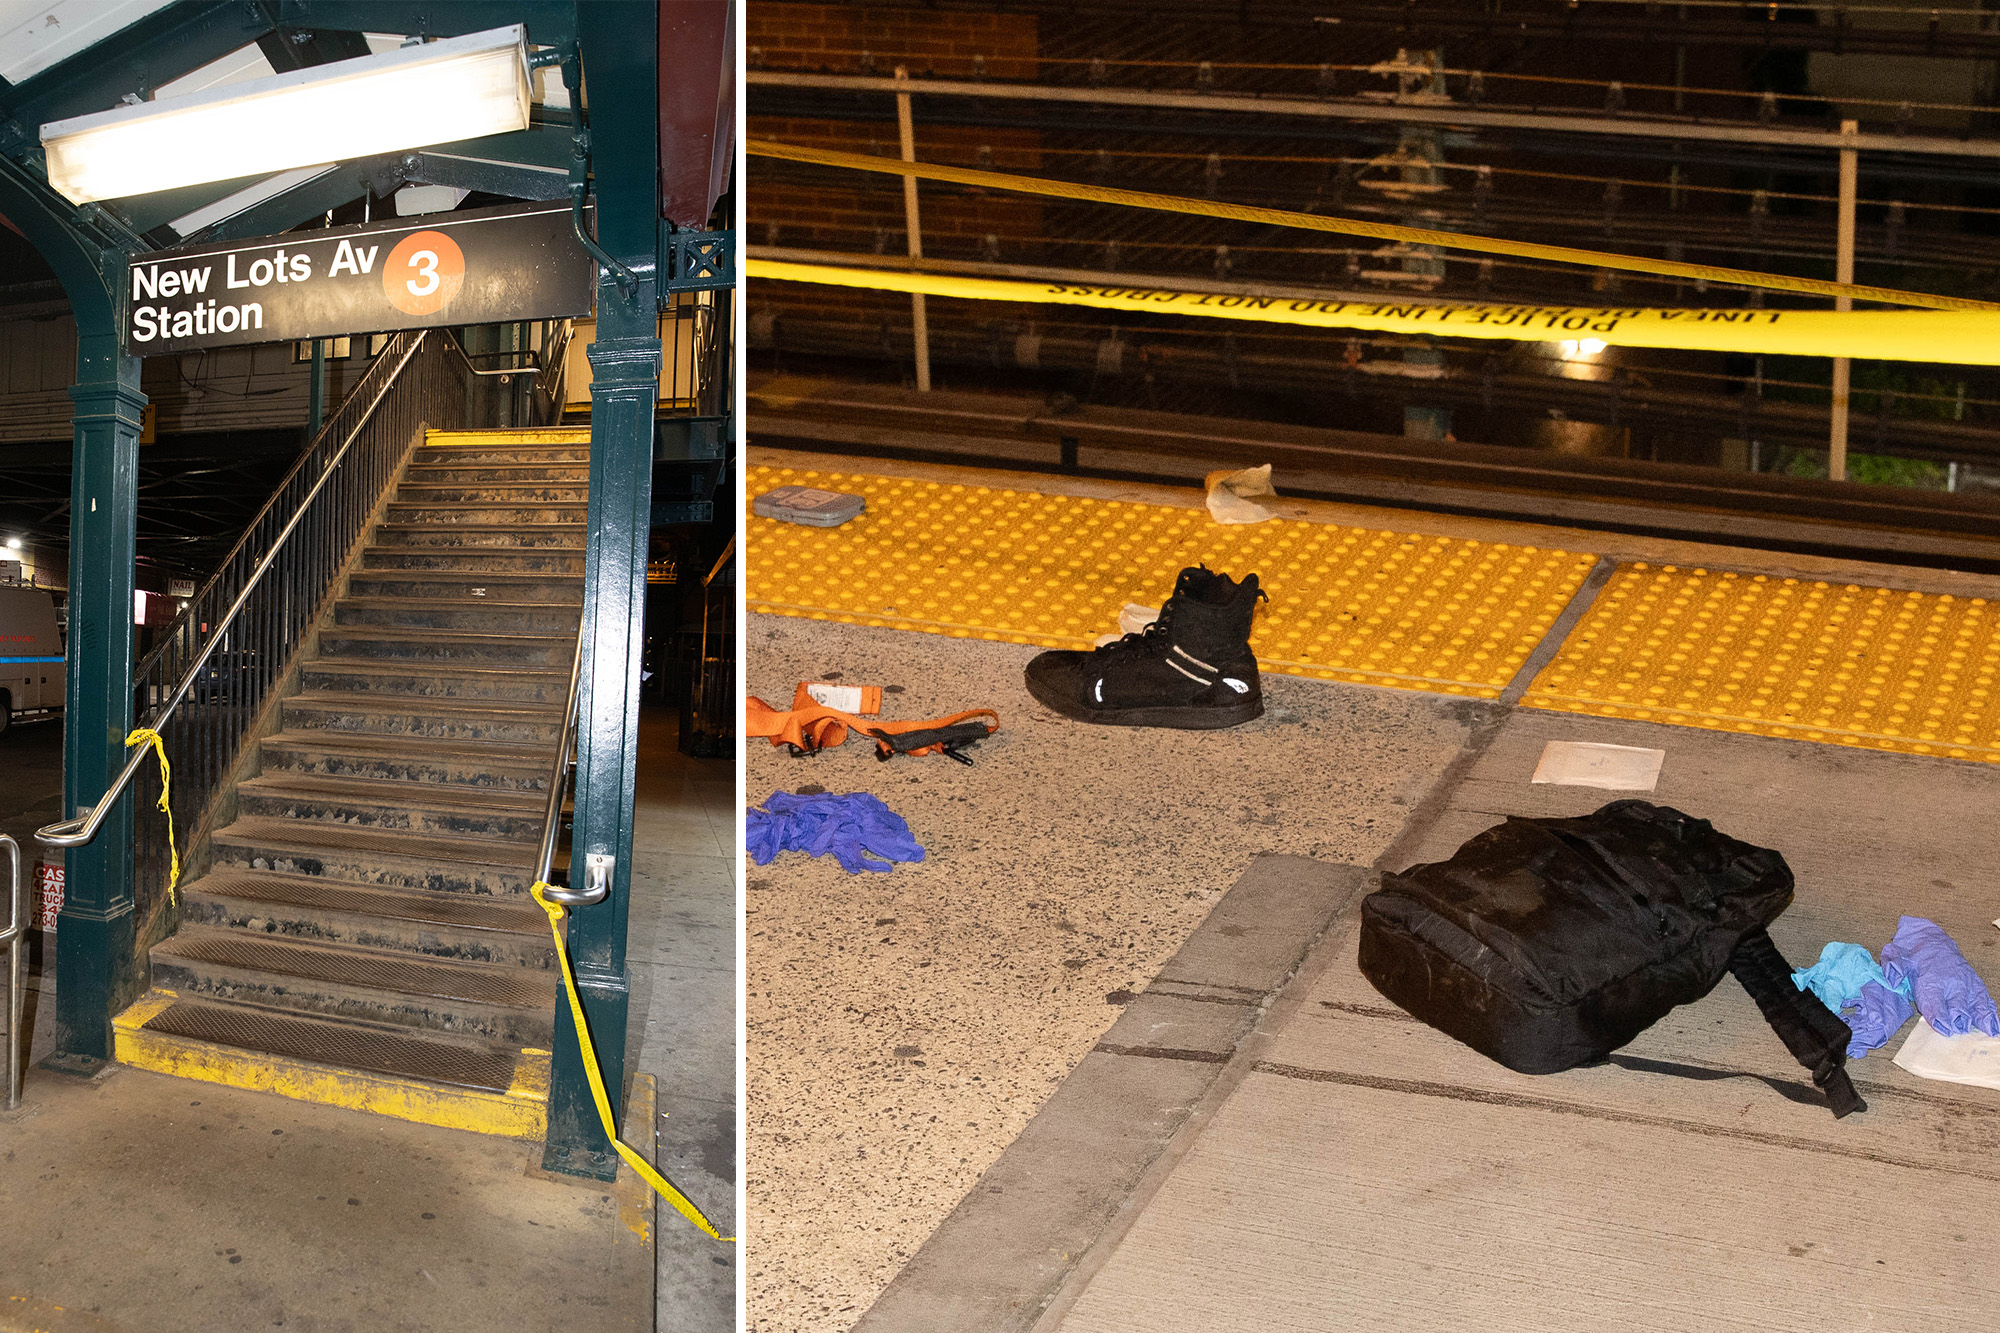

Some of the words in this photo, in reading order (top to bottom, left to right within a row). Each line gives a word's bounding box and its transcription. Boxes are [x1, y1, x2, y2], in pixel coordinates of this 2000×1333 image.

[132, 264, 212, 301] New
[226, 250, 312, 289] Lots
[328, 239, 378, 277] Av
[405, 250, 441, 297] 3
[1047, 284, 1181, 304] CROSS
[1189, 294, 1276, 311] NOT
[1290, 300, 1348, 314] DO
[1357, 304, 1454, 321] LINE
[131, 298, 263, 342] Station
[1465, 311, 1619, 333] POLICE
[173, 580, 193, 589] NAIL
[32, 911, 57, 928] 273-0
